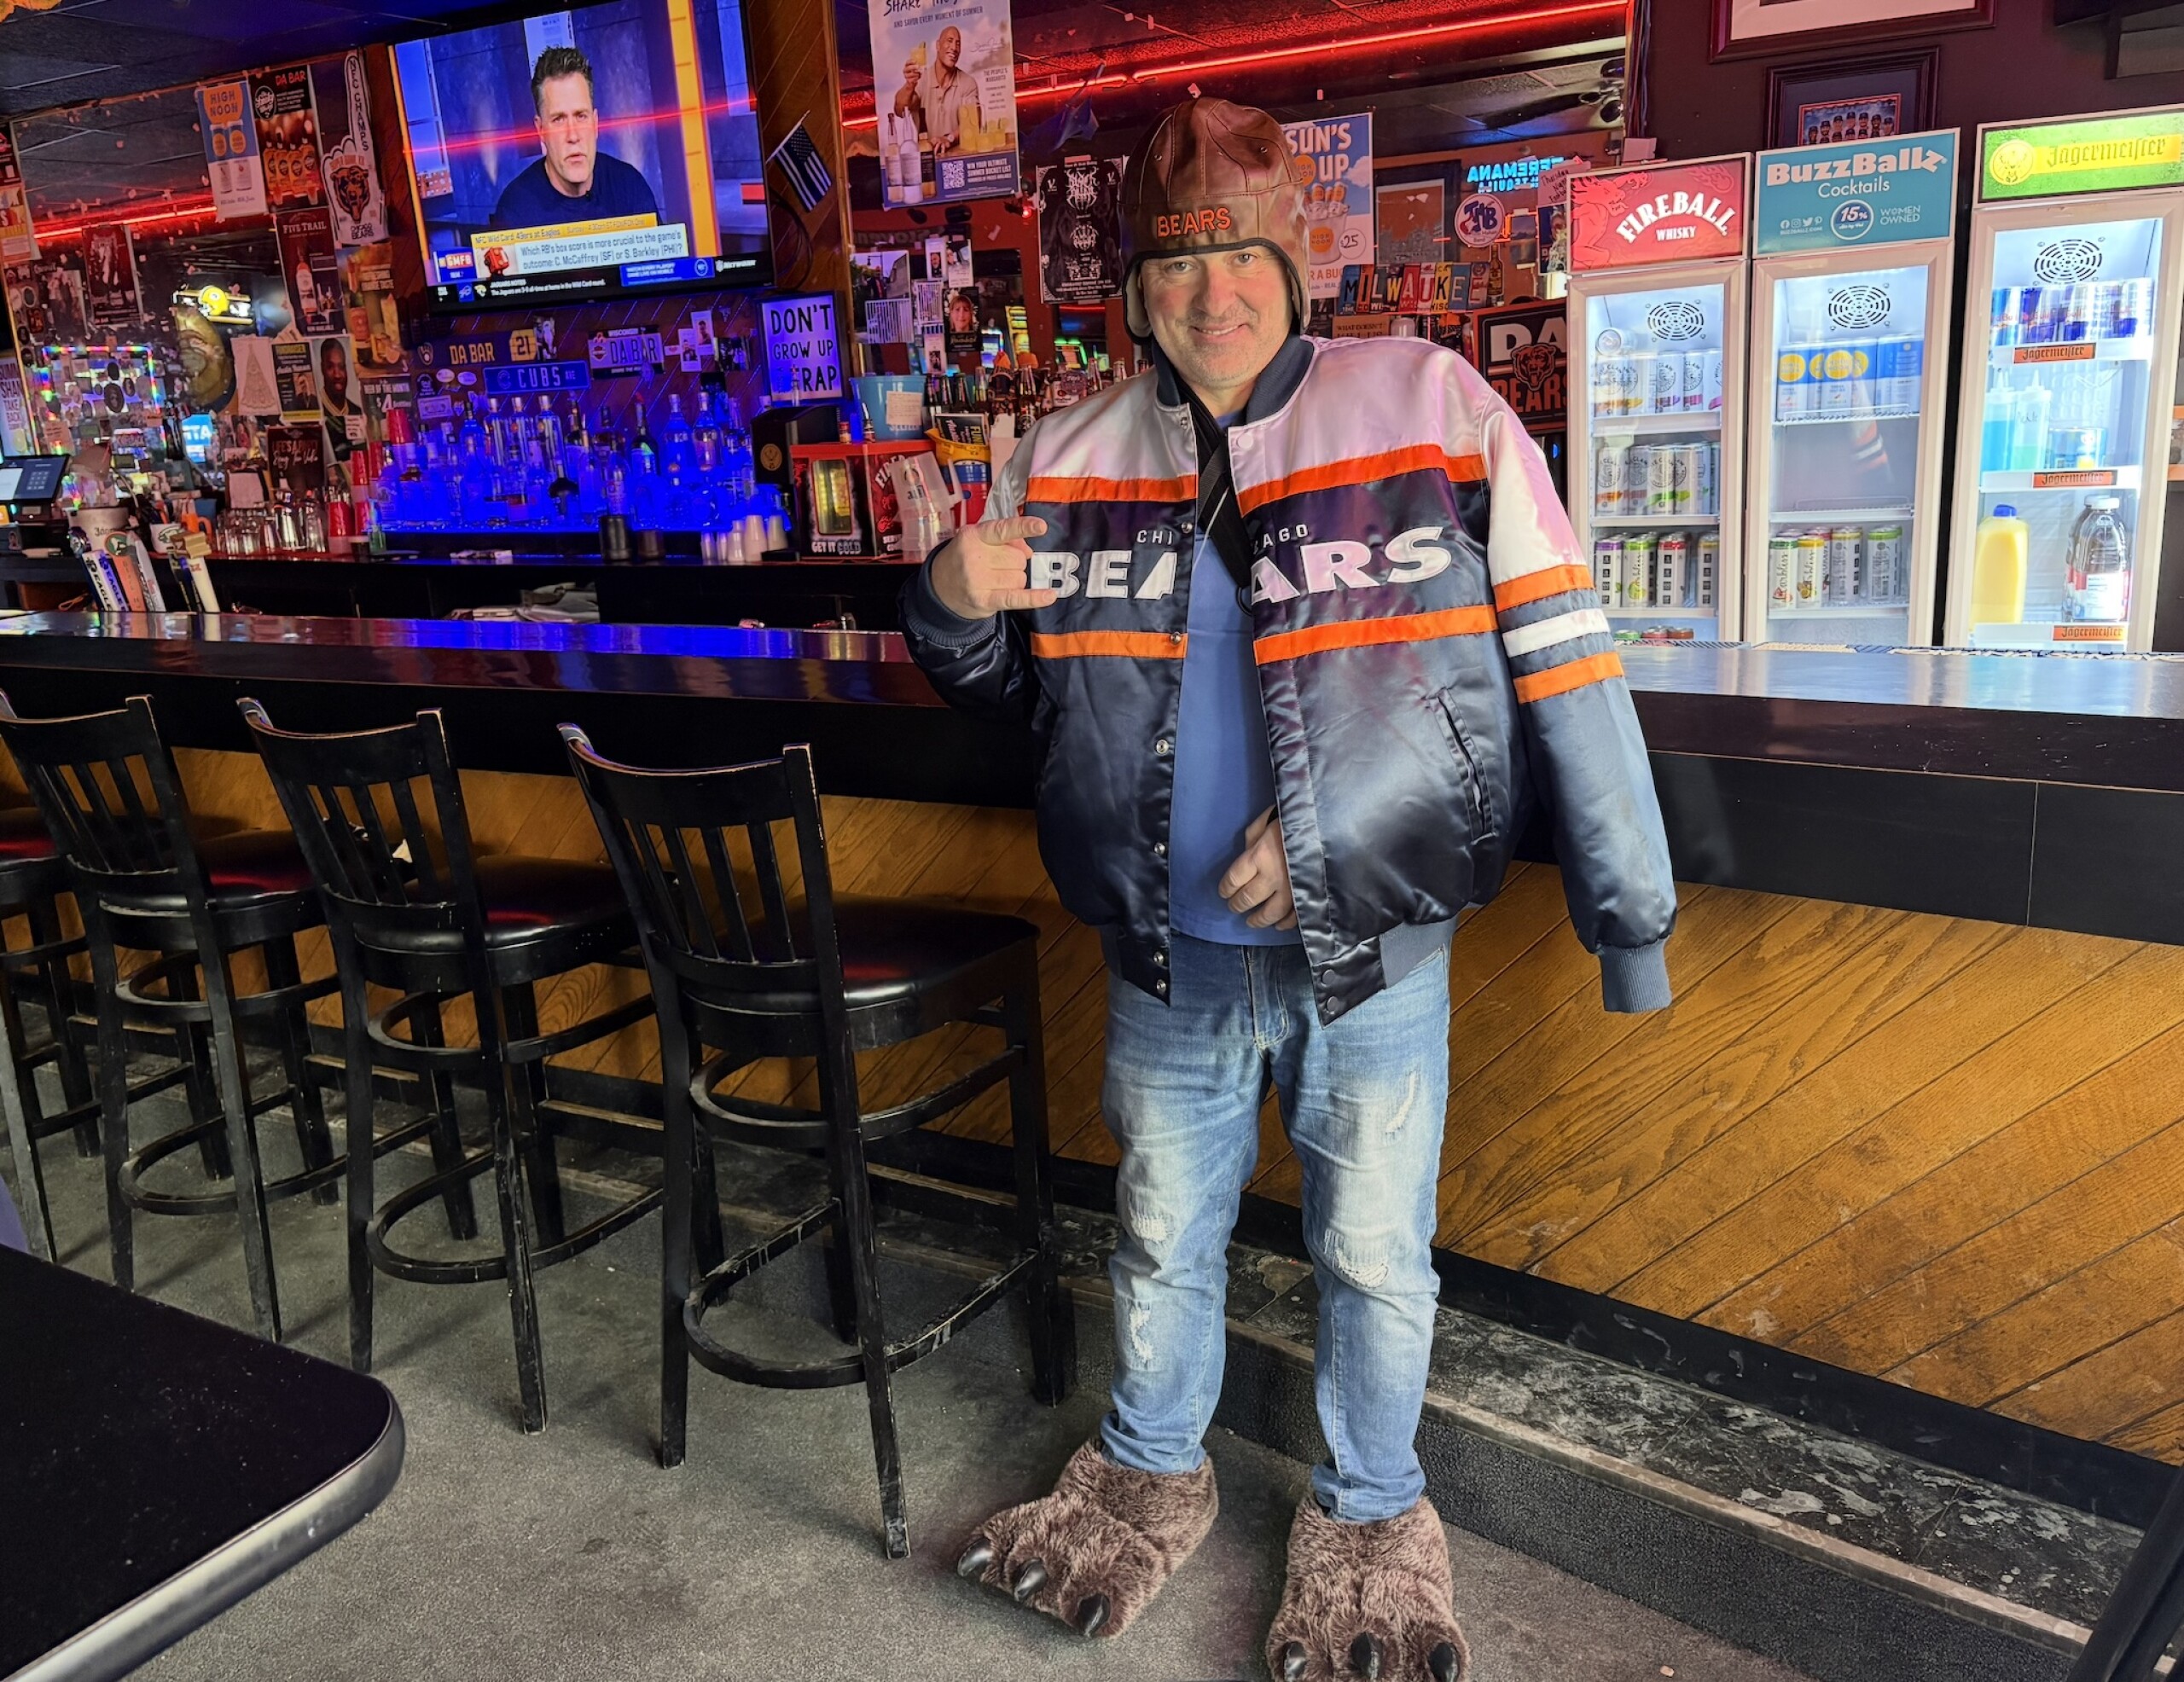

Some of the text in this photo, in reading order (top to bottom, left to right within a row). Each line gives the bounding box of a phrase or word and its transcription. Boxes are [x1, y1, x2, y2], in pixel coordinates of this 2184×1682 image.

[919, 14, 933, 24] EVERY
[935, 11, 955, 20] MOMENT
[962, 6, 984, 17] SUMMER
[275, 69, 306, 85] DA BAR
[210, 90, 235, 105] HIGH
[210, 102, 239, 117] NOON
[349, 60, 369, 152] NFC CHAMPS
[1285, 122, 1352, 155] SUN'S
[967, 168, 985, 177] SUMMER
[985, 166, 1002, 175] BUCKET
[976, 160, 988, 169] YOUR
[987, 158, 1007, 167] ULTIMATE
[1318, 154, 1350, 183] UP
[1766, 147, 1944, 187] BuzzBallz
[1817, 176, 1891, 199] Cocktails
[1615, 191, 1736, 244] FIREBALL
[1840, 206, 1868, 223] 15%
[1879, 205, 1921, 217] WOMEN
[350, 223, 373, 231] CHICAGO
[1156, 206, 1232, 238] BEARS
[1879, 213, 1920, 226] OWNED
[282, 224, 301, 235] FIVE
[302, 221, 327, 232] TRAIL
[351, 229, 375, 240] BEARS
[541, 229, 561, 239] Eagles
[1655, 225, 1697, 241] WHISKY
[520, 229, 682, 257] Which RB's box score is more crucial to the game's
[1311, 237, 1331, 246] NOON
[1339, 234, 1360, 249] $25
[446, 253, 472, 267] GMFB
[522, 258, 554, 270] outcome:
[562, 252, 598, 265] McCaffrey
[615, 251, 624, 260] or
[624, 249, 630, 259] S.
[632, 246, 659, 258] Barkley
[770, 304, 832, 335] DON'T
[515, 335, 531, 357] 21
[1490, 316, 1567, 362] DA
[449, 342, 496, 365] DA BAR
[610, 336, 659, 364] DA BAR
[774, 339, 834, 360] GROW UP
[517, 367, 576, 389] CUBS AVE
[392, 382, 410, 393] MONTH
[1490, 373, 1566, 413] BEAR
[3, 398, 20, 411] TAKE
[6, 411, 21, 422] BACK
[811, 541, 862, 555] GET IT COLD
